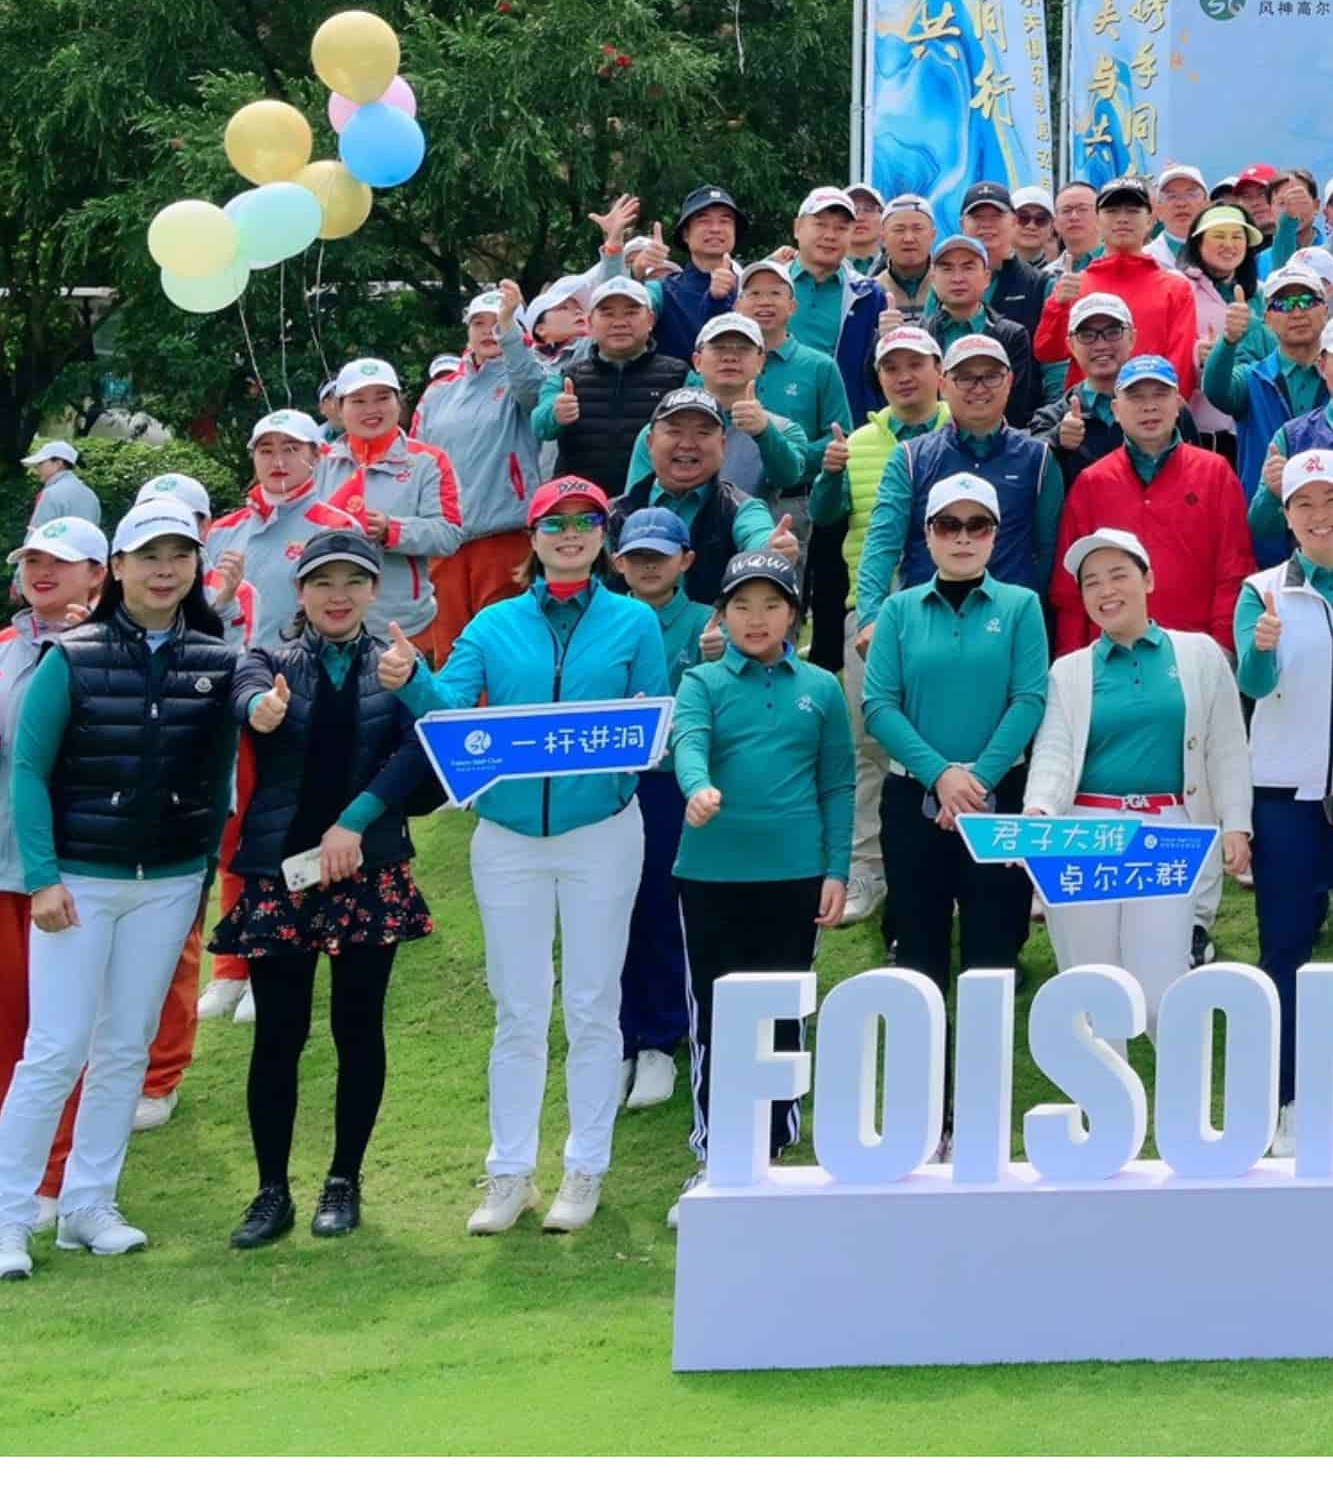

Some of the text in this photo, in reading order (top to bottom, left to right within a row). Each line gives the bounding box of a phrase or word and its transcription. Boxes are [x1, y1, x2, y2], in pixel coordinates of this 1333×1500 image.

[511, 724, 645, 756] 一杆进洞
[992, 820, 1127, 854] 君子大雅
[1060, 860, 1188, 895] 卓尔不群
